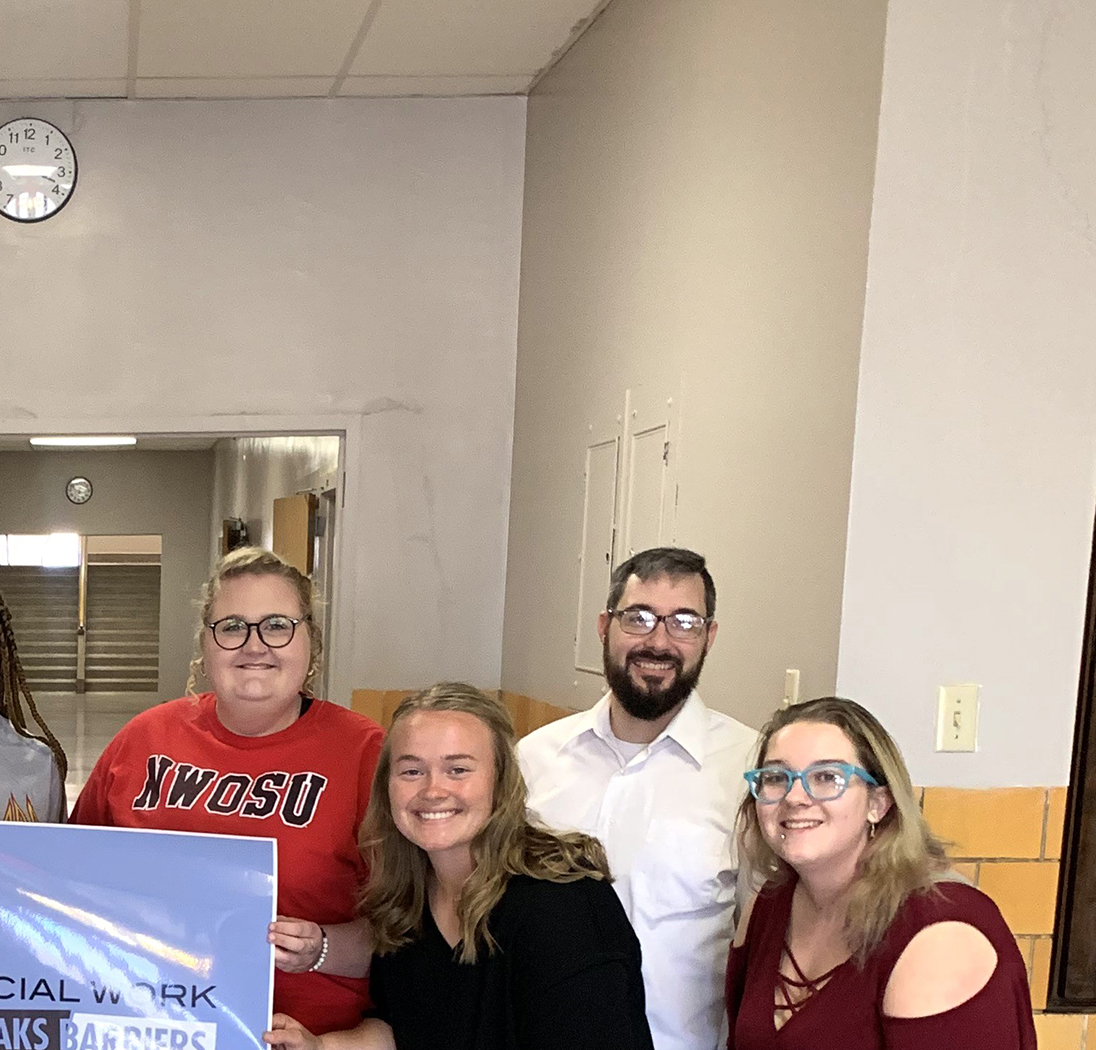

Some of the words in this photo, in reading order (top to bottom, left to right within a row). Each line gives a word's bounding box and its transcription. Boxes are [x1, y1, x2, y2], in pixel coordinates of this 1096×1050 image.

[9, 132, 19, 144] 11
[23, 128, 36, 140] 12
[45, 134, 50, 146] 1
[54, 147, 63, 160] 2
[57, 166, 66, 178] 3
[51, 184, 61, 195] 4
[6, 193, 14, 204] 7
[132, 754, 328, 828] NWOSU
